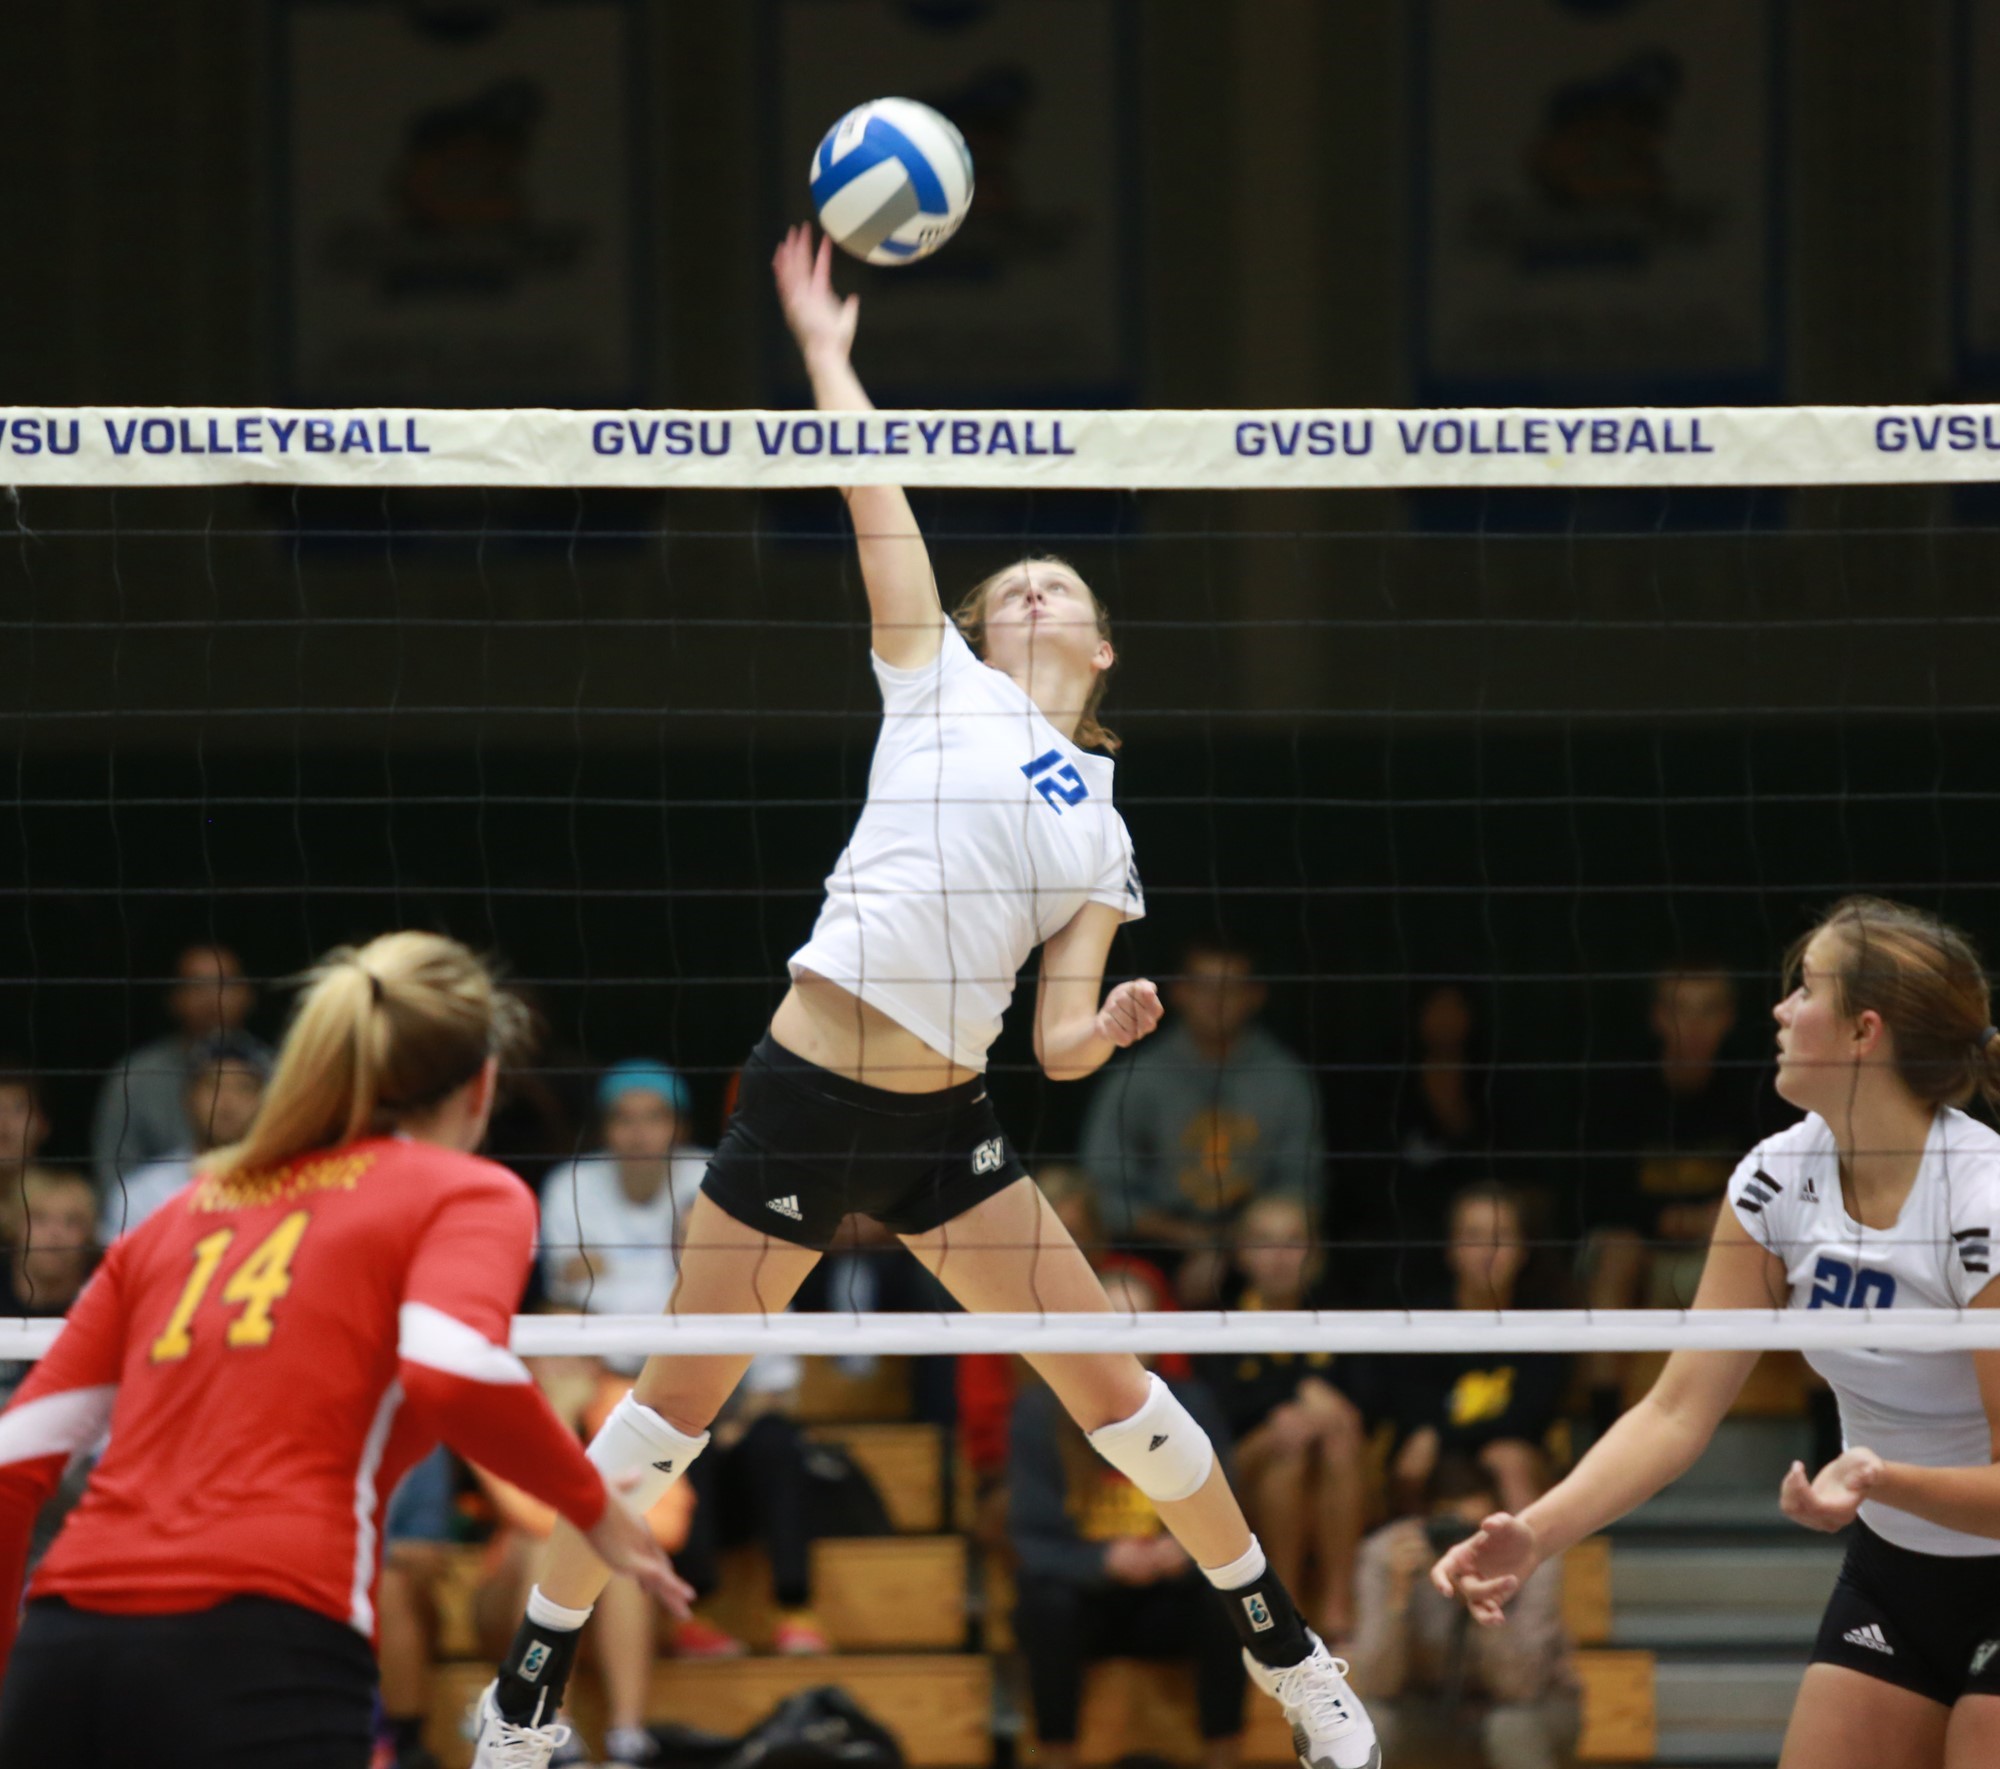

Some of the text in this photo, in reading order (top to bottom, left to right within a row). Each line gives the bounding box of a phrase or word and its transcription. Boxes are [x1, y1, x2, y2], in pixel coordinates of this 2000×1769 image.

[0, 418, 430, 455] SU VOLLEYBALL
[592, 420, 1075, 456] GVSU VOLLEYBALL
[1235, 418, 1713, 457] GVSU VOLLEYBALL
[1020, 749, 1089, 816] 12
[150, 1210, 309, 1363] 14
